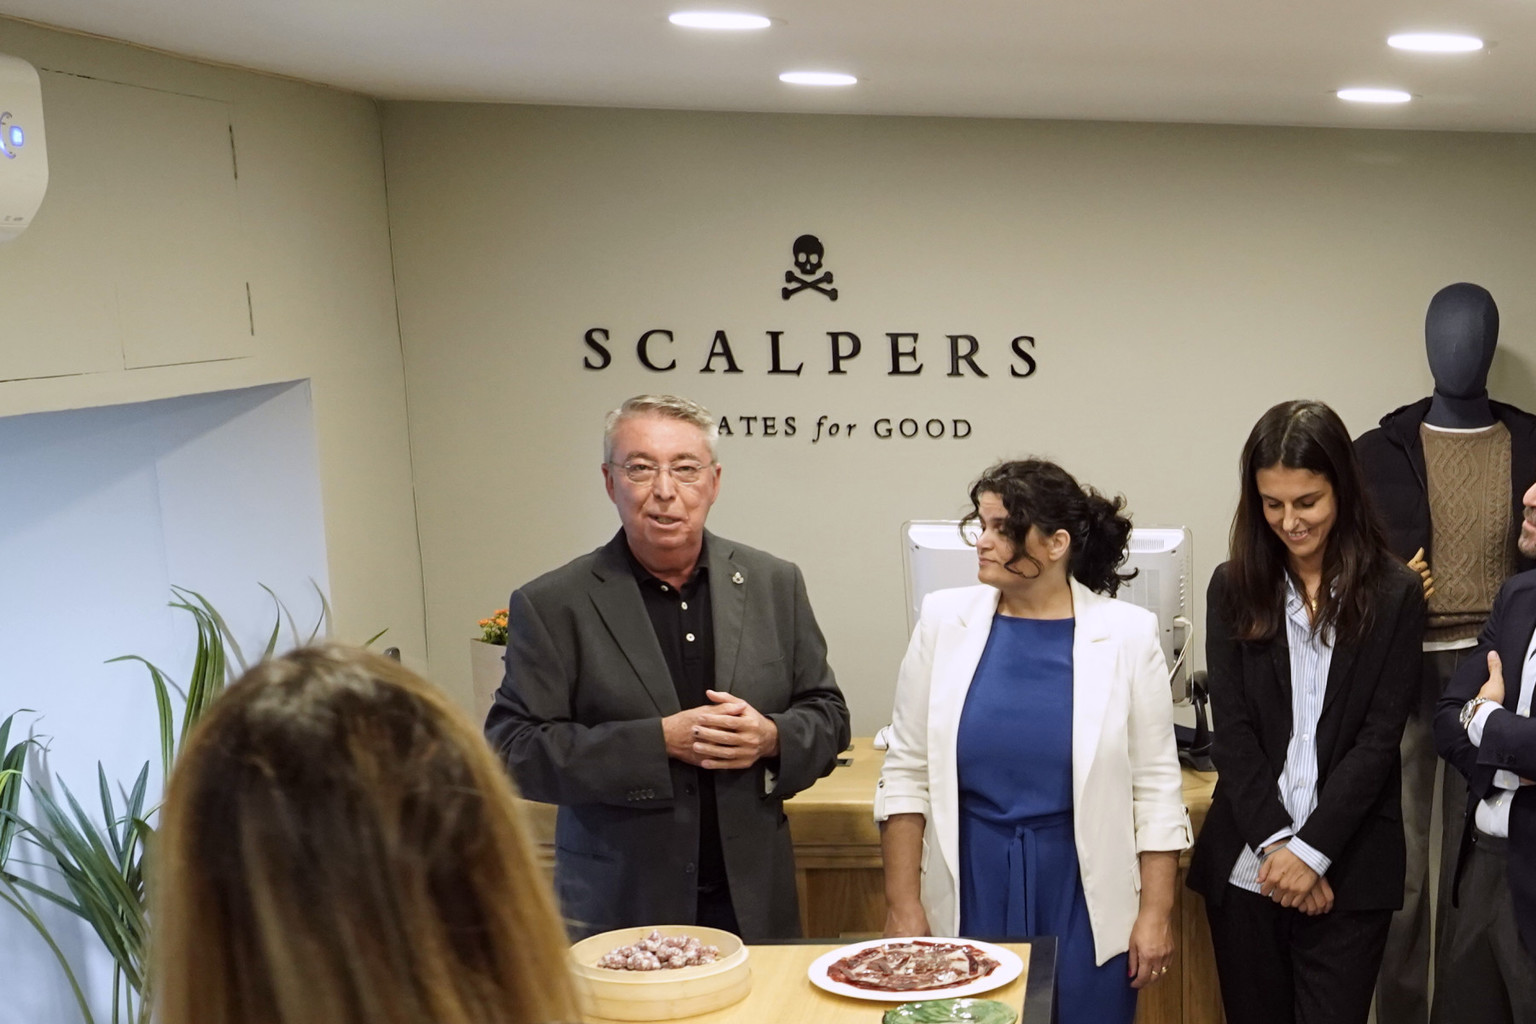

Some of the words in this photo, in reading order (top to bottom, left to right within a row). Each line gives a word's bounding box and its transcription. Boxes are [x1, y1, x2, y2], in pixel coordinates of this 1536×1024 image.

[582, 327, 1038, 378] SCALPERS
[717, 415, 797, 436] ATES
[812, 415, 857, 443] for
[873, 418, 973, 439] GOOD
